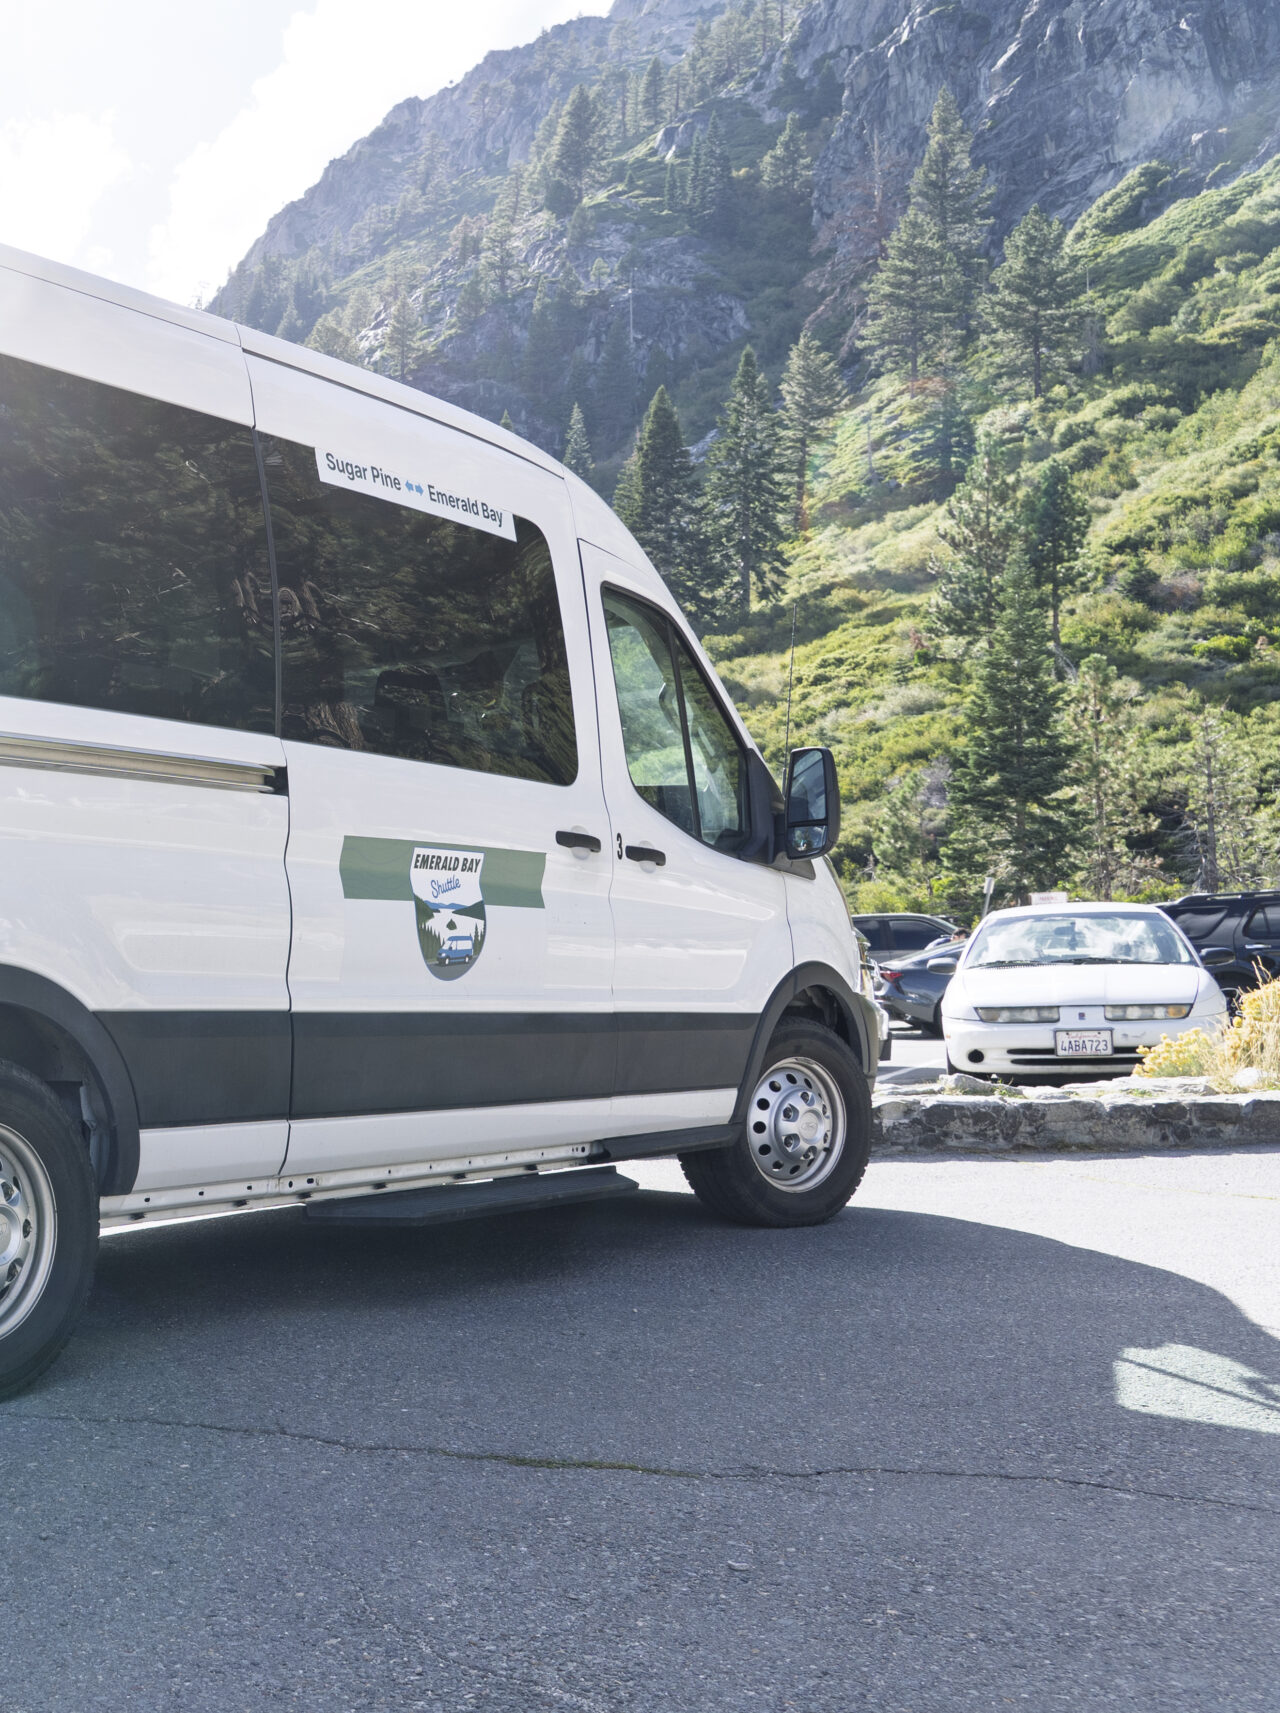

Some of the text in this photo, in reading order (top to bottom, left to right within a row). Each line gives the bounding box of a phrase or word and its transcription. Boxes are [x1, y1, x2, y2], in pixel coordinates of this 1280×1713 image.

[326, 452, 503, 528] Sugar Pine Emerald Bay
[616, 832, 624, 860] 3
[414, 853, 481, 873] EMERALD BAY
[430, 874, 462, 899] Shuttle
[1060, 1039, 1109, 1052] 4ABA723
